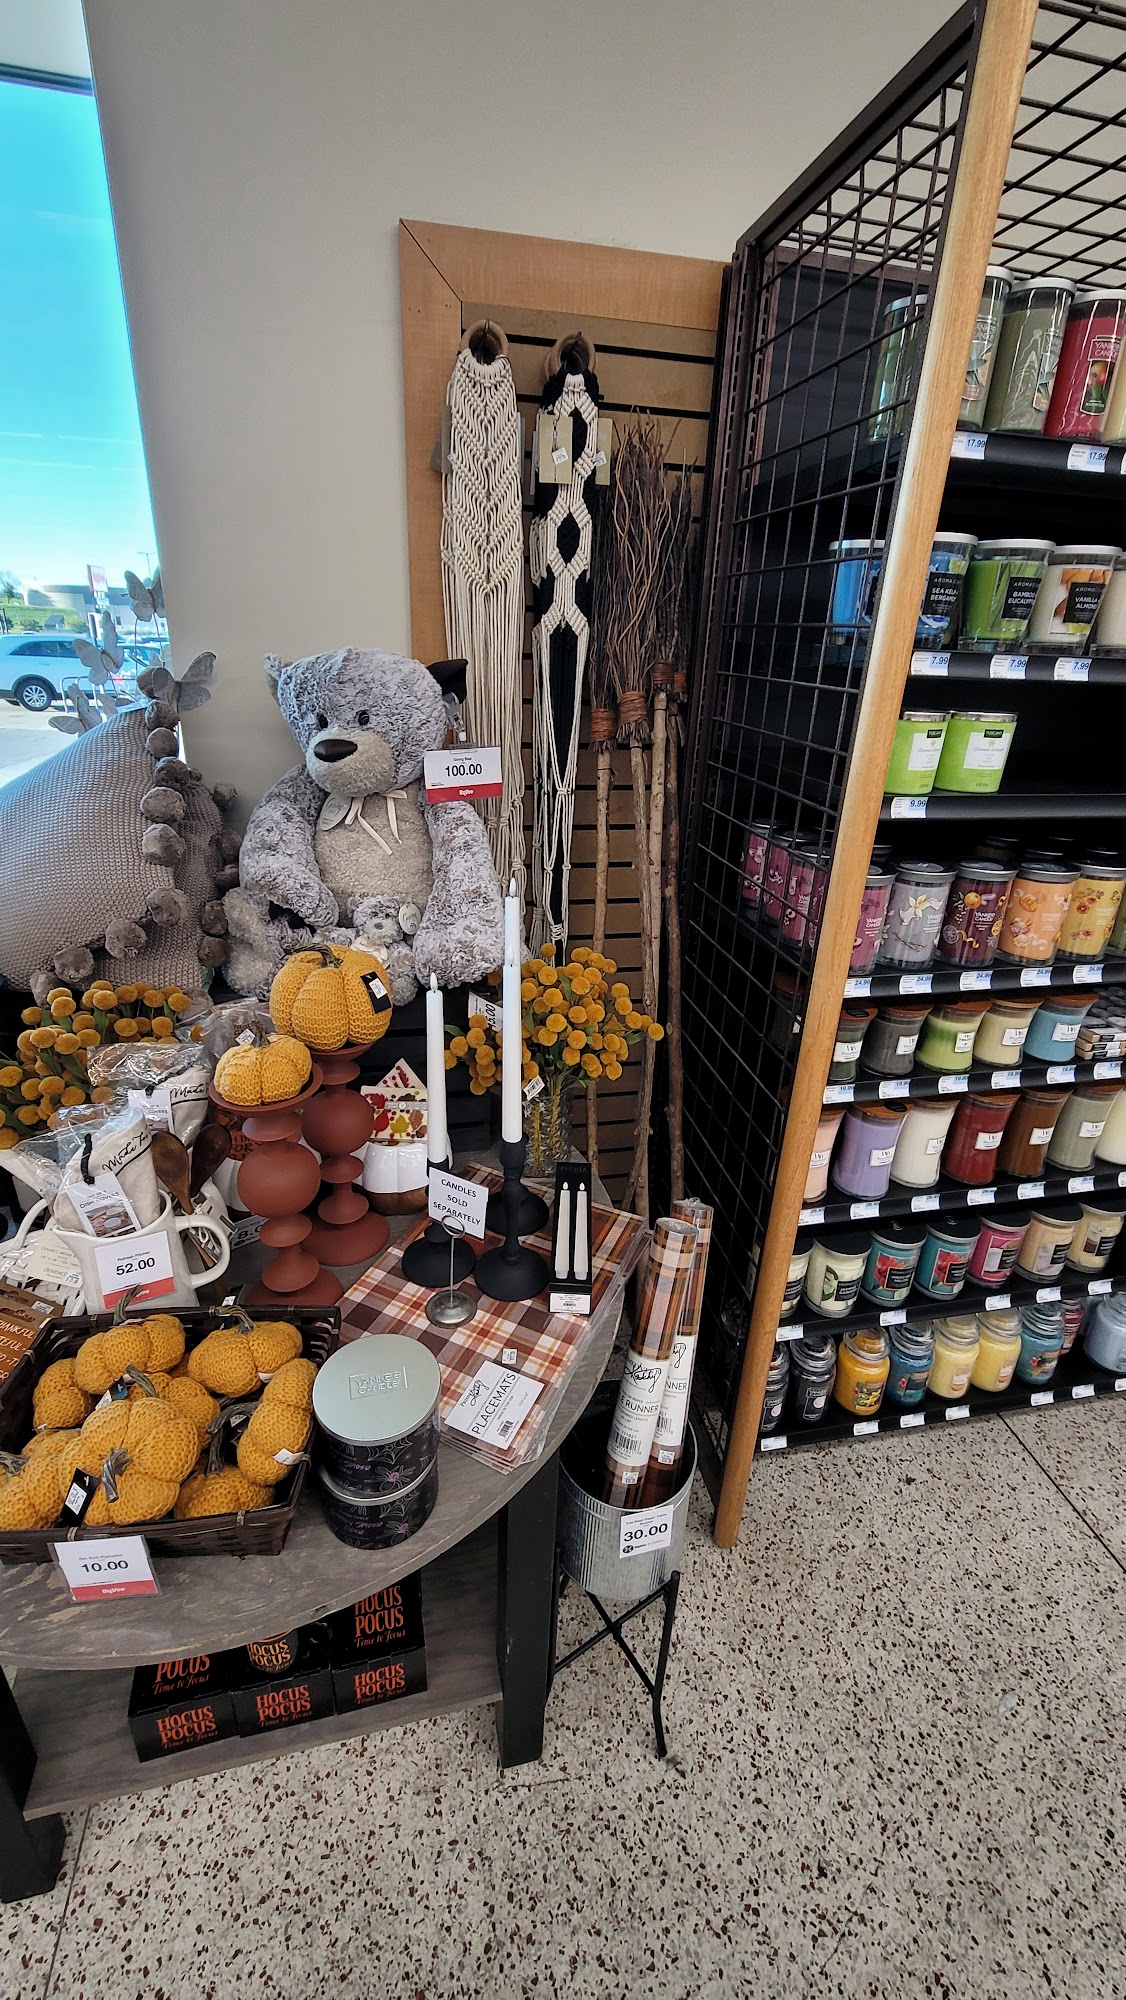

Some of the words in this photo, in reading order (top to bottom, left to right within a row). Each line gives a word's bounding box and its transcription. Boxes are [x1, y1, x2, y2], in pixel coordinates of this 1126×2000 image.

[967, 438, 986, 448] 17.99
[1088, 452, 1106, 460] 17.99
[931, 656, 948, 665] 7.99
[1010, 659, 1026, 668] 7.99
[1073, 662, 1090, 670] 7.99
[445, 764, 482, 776] 100.00
[441, 1178, 476, 1198] CANDLES
[447, 1194, 468, 1207] SOLD
[433, 1202, 481, 1225] SEPARATELY
[116, 1258, 155, 1276] 52.00
[354, 1371, 400, 1386] YANKEE
[358, 1379, 399, 1394] CANDLE
[665, 1381, 687, 1390] NNER
[472, 1372, 516, 1434] PLACEMATS
[625, 1400, 659, 1413] RUNNER
[624, 1524, 668, 1542] 30.00
[81, 1560, 128, 1573] 10.00
[354, 1586, 402, 1616] HOCUS
[354, 1606, 404, 1637] POCUS
[354, 1637, 374, 1648] Time
[155, 1655, 210, 1683] POCUS
[354, 1663, 404, 1687] HOCUS
[152, 1683, 174, 1694] Time
[177, 1680, 184, 1688] to
[356, 1675, 405, 1699] POCUS
[256, 1684, 309, 1709] HOCUS
[257, 1698, 311, 1721] POCUS
[156, 1706, 214, 1731] HOCUS
[160, 1719, 216, 1744] POCUS
